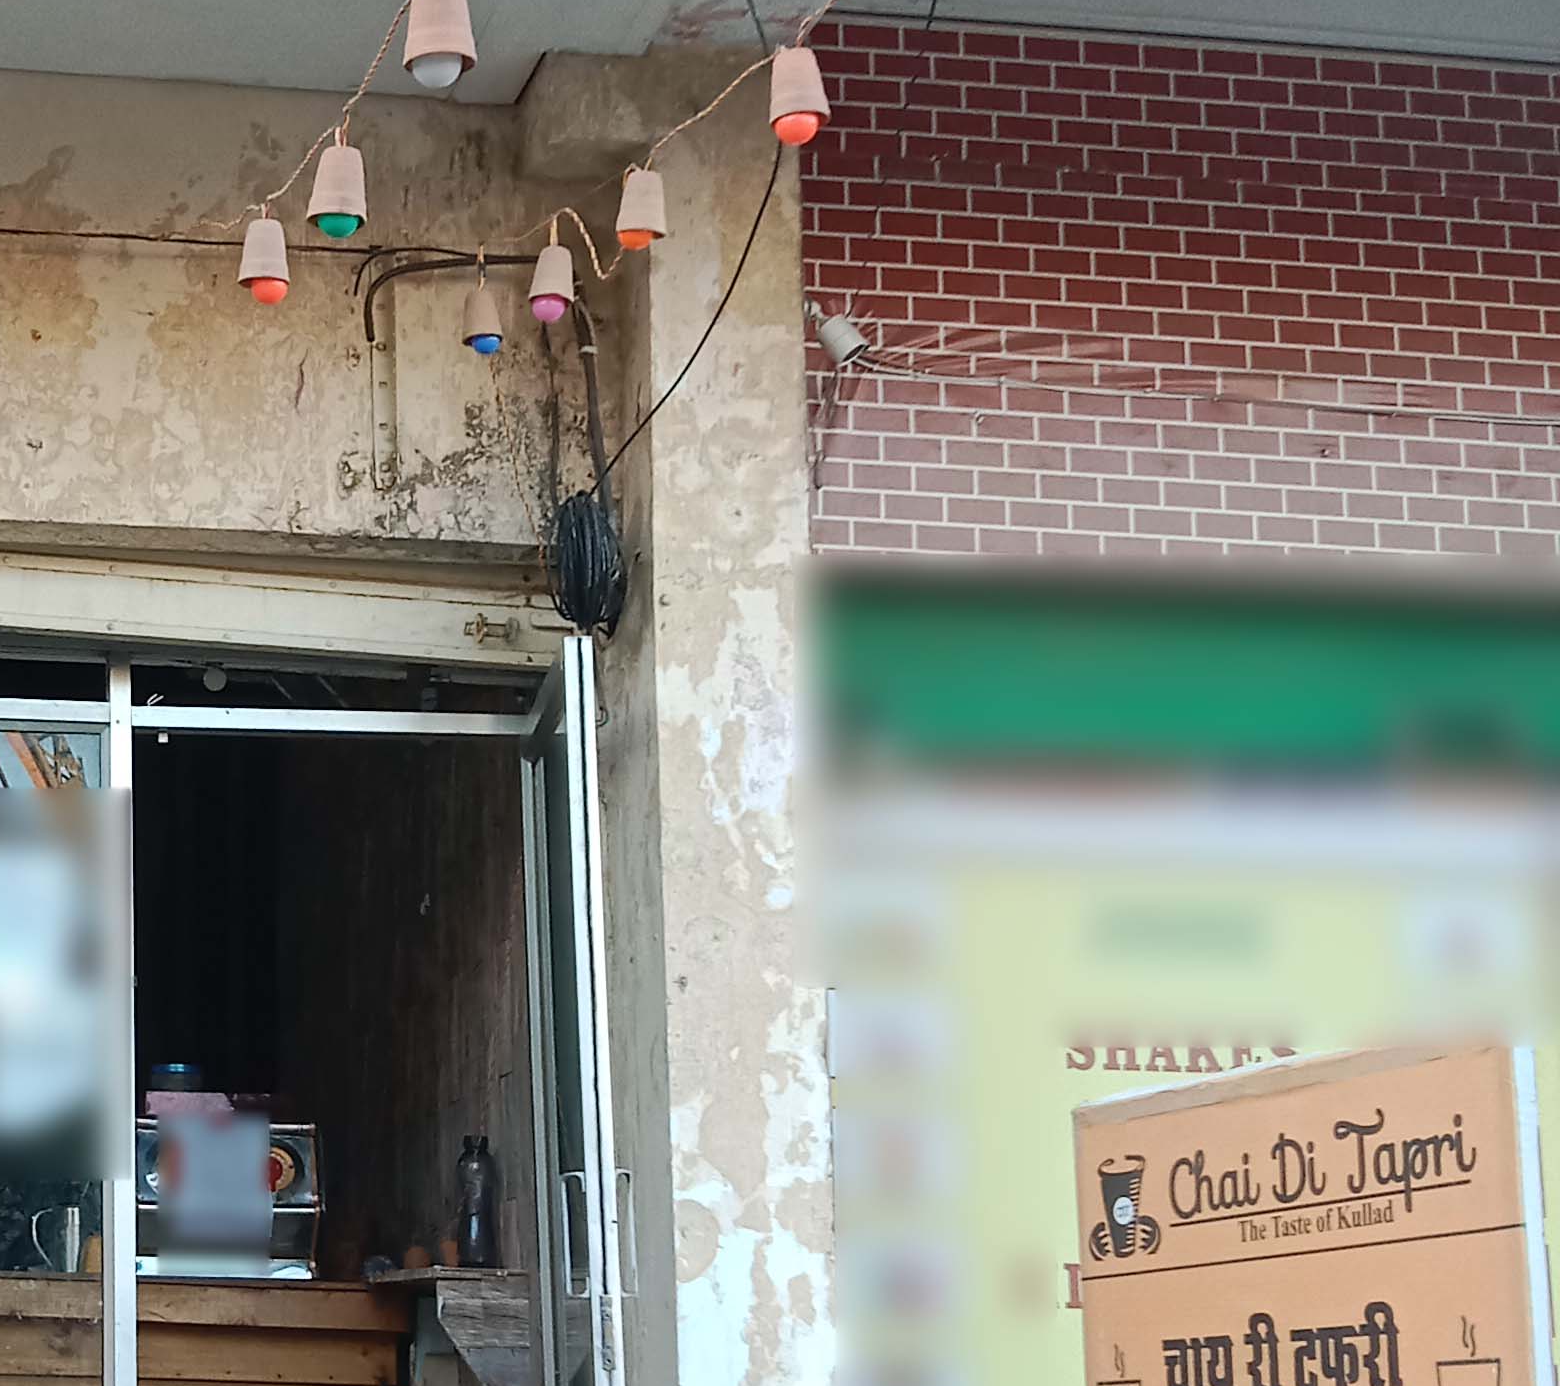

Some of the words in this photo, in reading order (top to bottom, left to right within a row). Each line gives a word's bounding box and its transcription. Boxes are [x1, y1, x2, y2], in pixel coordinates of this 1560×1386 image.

[1169, 1150, 1260, 1220] Chai
[1273, 1132, 1326, 1204] Di
[1333, 1108, 1477, 1213] Tapri
[1238, 1218, 1267, 1244] The
[1271, 1212, 1312, 1240] Taste
[1316, 1212, 1334, 1232] of
[1336, 1199, 1396, 1231] Kullad
